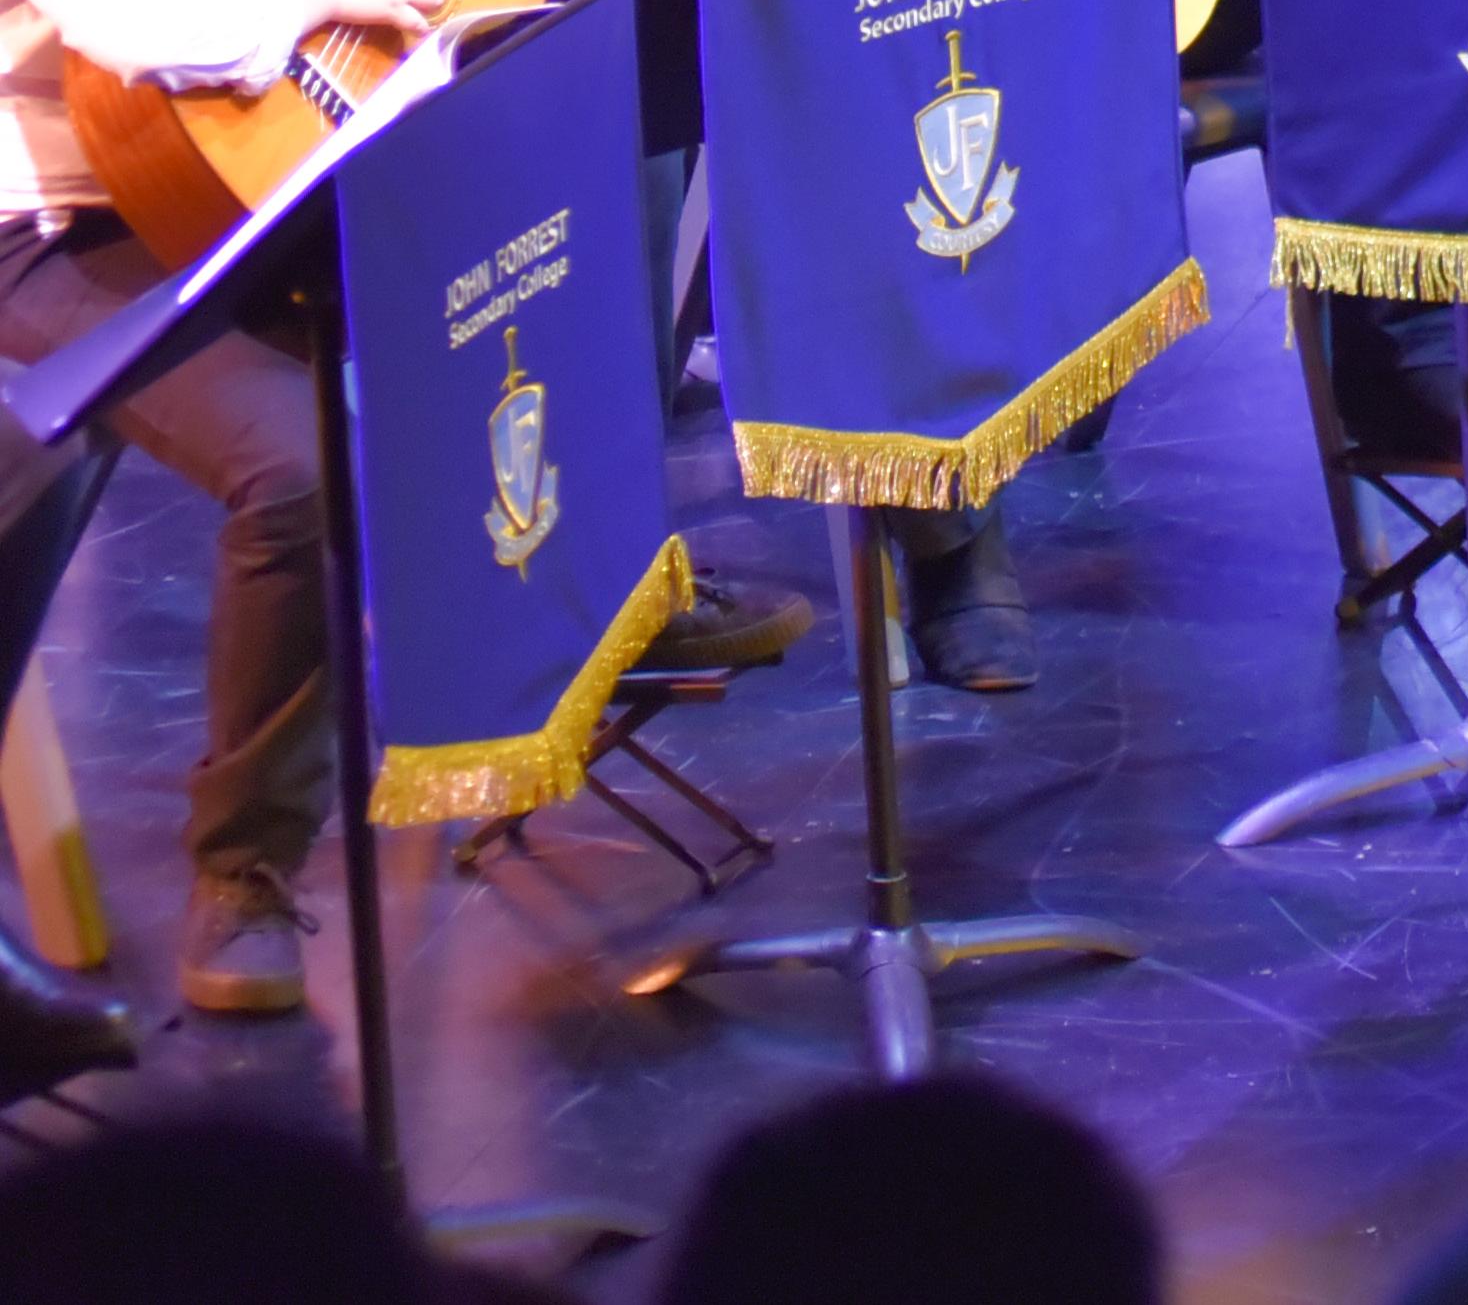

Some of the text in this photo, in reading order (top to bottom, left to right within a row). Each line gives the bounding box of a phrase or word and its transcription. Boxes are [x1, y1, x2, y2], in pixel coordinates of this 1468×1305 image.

[932, 105, 988, 190] JF
[445, 208, 570, 318] JOHN FORREST
[449, 255, 569, 350] Secondary College
